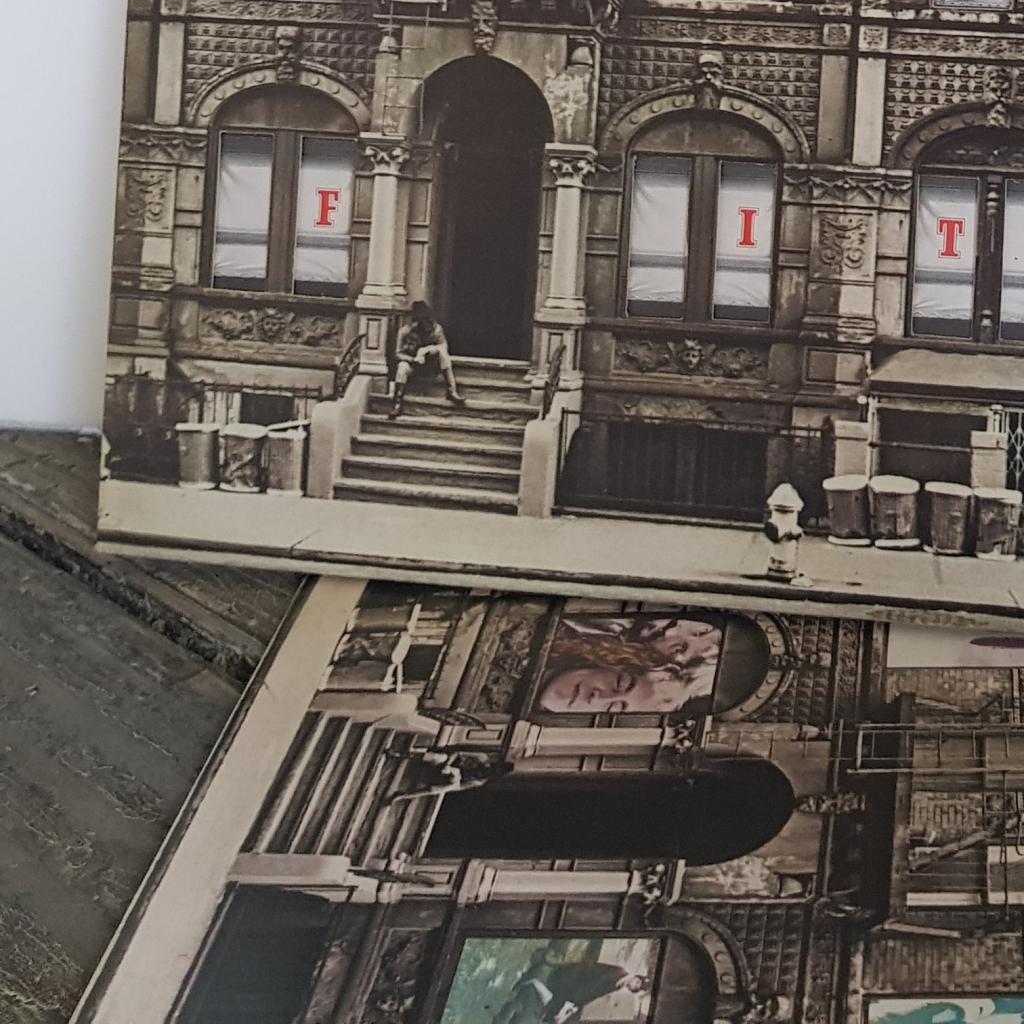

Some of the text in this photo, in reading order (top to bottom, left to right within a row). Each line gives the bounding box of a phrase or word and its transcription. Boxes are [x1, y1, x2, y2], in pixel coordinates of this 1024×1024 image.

[314, 188, 341, 228] F
[736, 207, 759, 248] I
[934, 218, 966, 258] T
